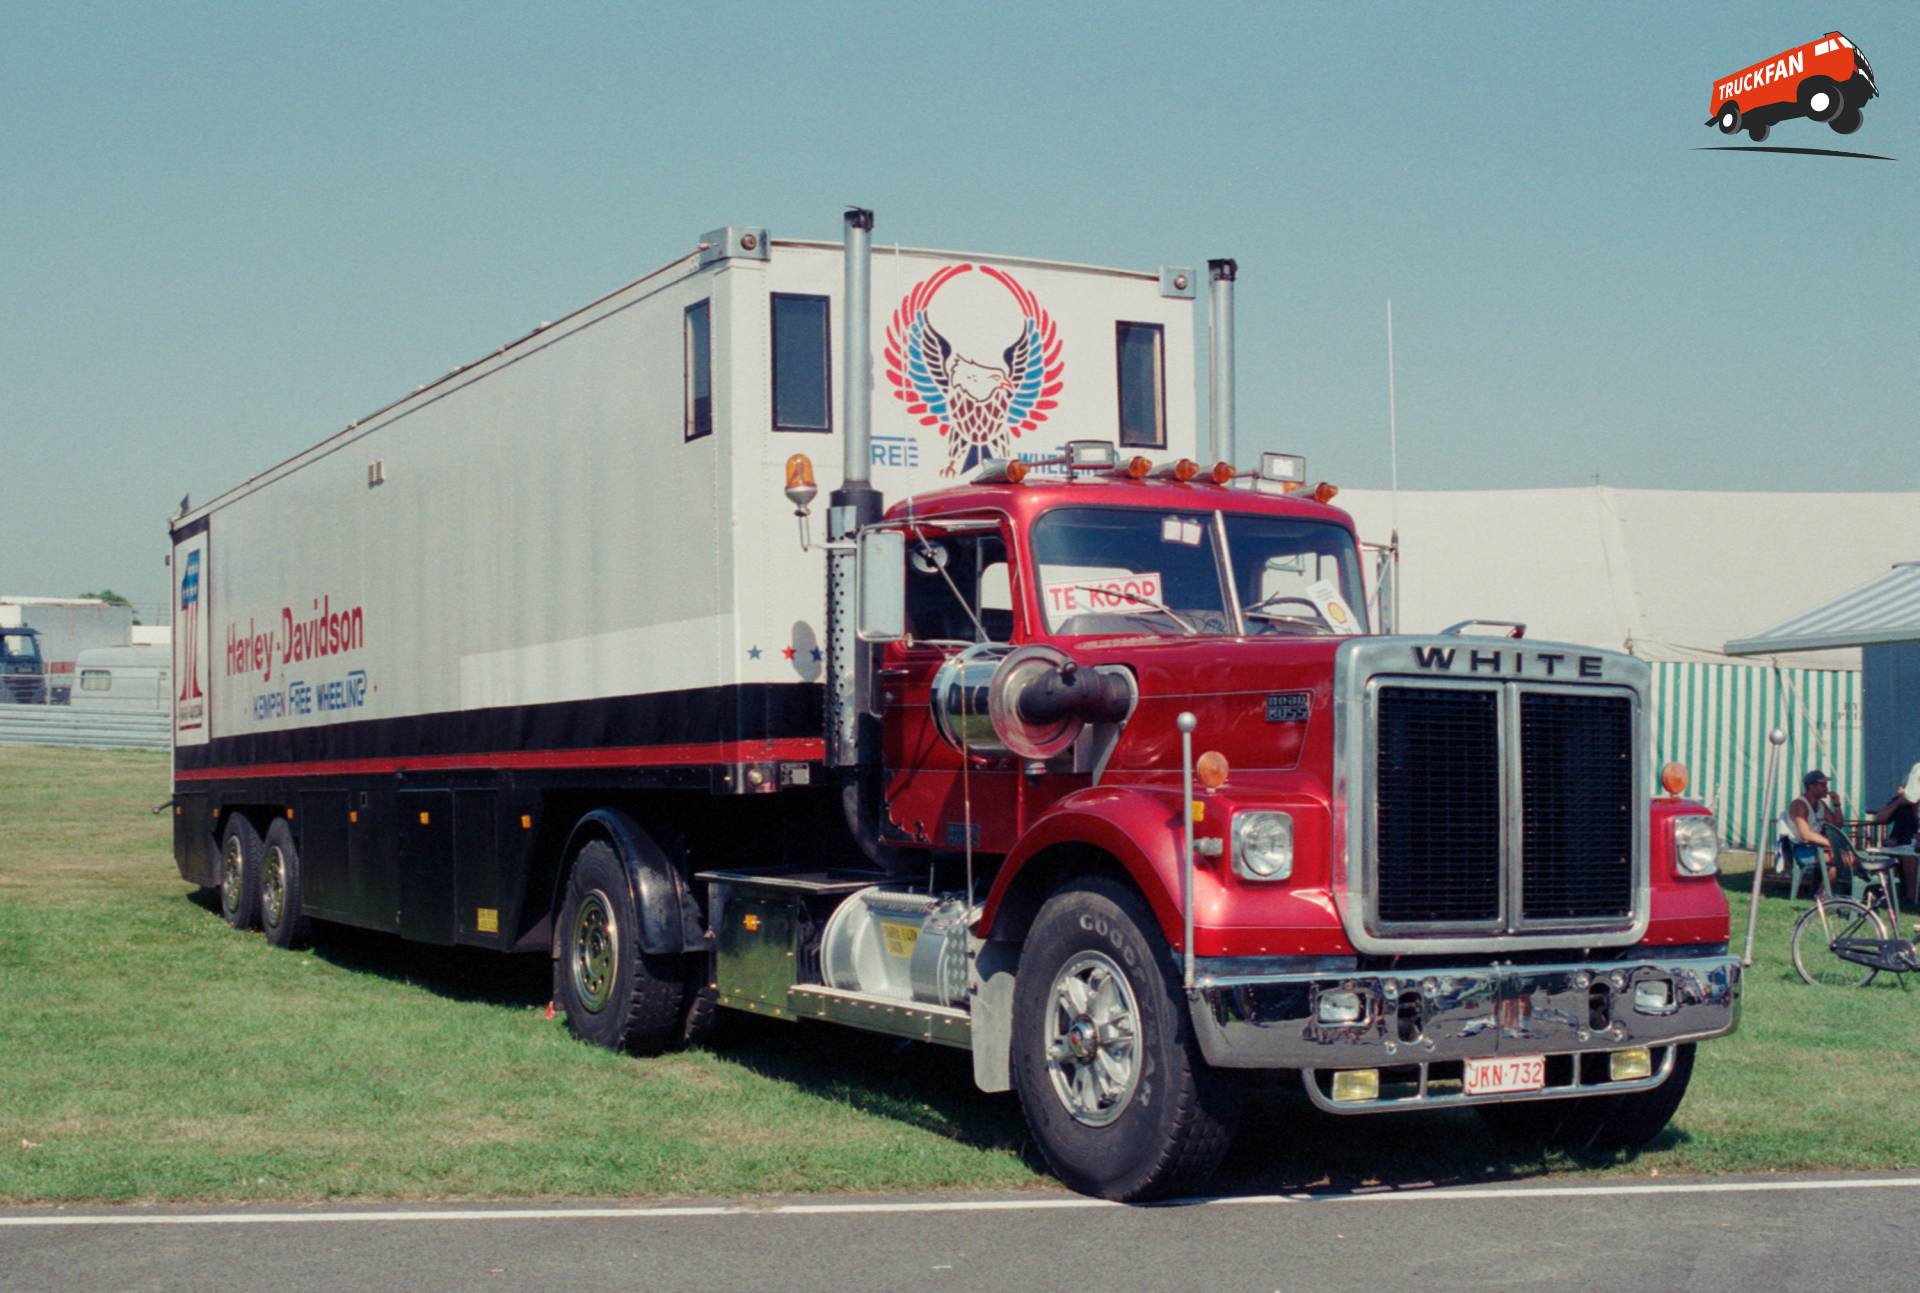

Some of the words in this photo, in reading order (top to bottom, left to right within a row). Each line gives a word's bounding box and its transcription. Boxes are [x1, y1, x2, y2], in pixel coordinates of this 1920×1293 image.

[871, 436, 919, 467] REE
[1049, 587, 1077, 610] TE
[1088, 581, 1156, 608] KOOP
[1412, 646, 1603, 677] WHITE
[288, 681, 311, 715] FREE
[317, 670, 367, 711] WHEELING
